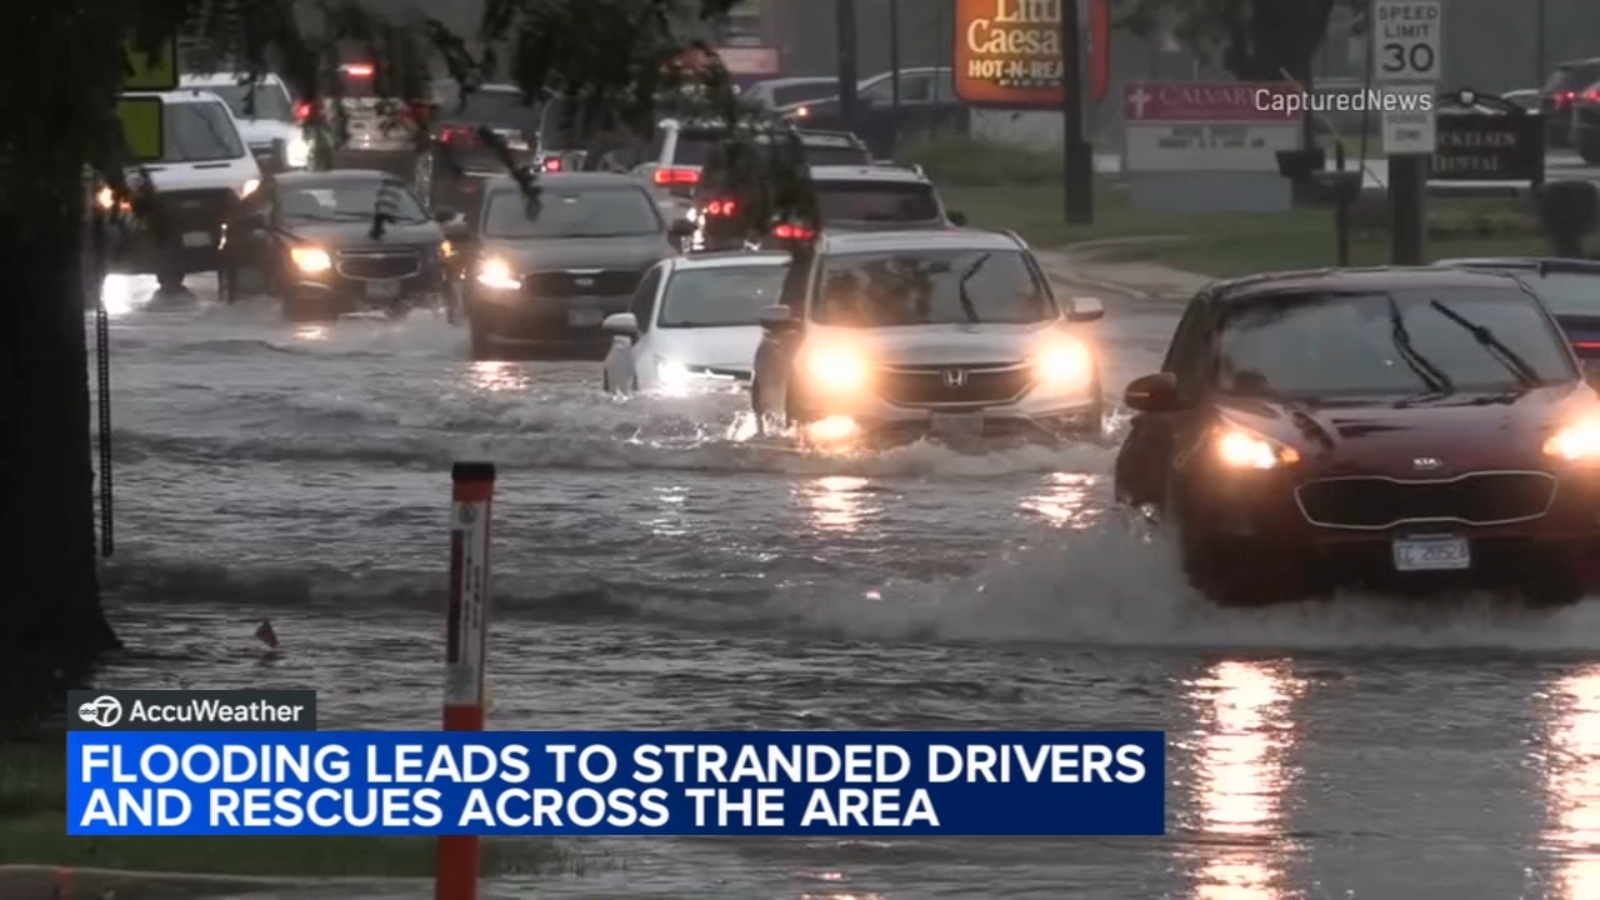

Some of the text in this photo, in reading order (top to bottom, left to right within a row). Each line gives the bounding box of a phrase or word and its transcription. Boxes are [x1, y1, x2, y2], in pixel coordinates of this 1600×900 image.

[994, 0, 1062, 22] Littl
[1378, 6, 1439, 21] SPEED
[967, 18, 1063, 54] Caesa
[1384, 25, 1430, 38] LIMIT
[1382, 43, 1435, 72] 30
[967, 59, 1064, 79] HOT-N-REA
